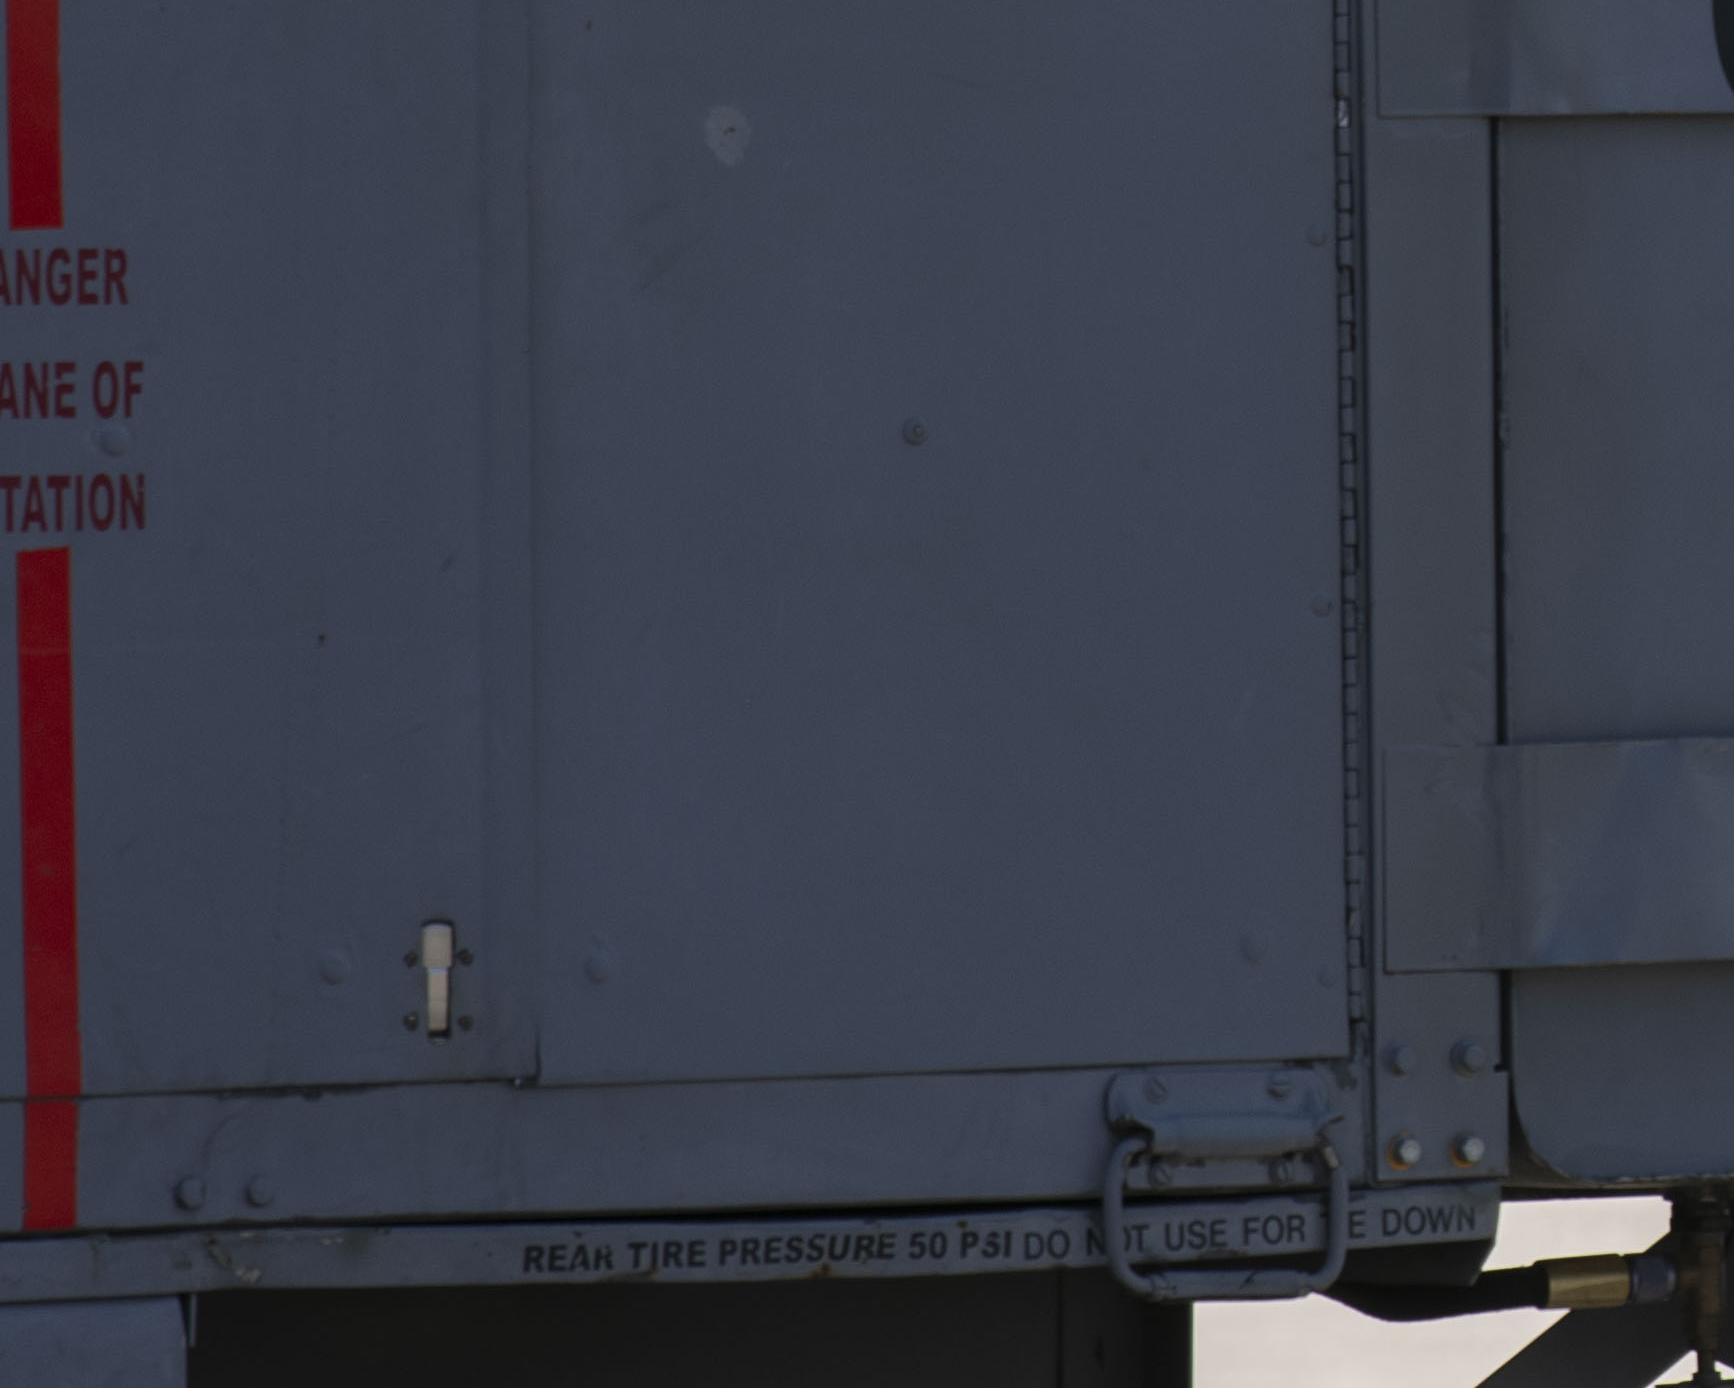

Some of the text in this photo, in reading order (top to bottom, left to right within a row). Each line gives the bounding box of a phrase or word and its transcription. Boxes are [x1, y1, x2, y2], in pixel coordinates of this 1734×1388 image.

[92, 360, 144, 419] OF
[0, 472, 146, 533] TATION
[522, 1243, 614, 1274] REAR
[627, 1239, 707, 1270] TIRE
[718, 1232, 898, 1267] PRESSURE
[907, 1230, 948, 1261] 50
[958, 1229, 1012, 1260] PSI
[1023, 1228, 1071, 1261] DO
[1164, 1219, 1228, 1252] USE
[1242, 1214, 1307, 1246] FOR
[1381, 1204, 1477, 1238] DOWN
